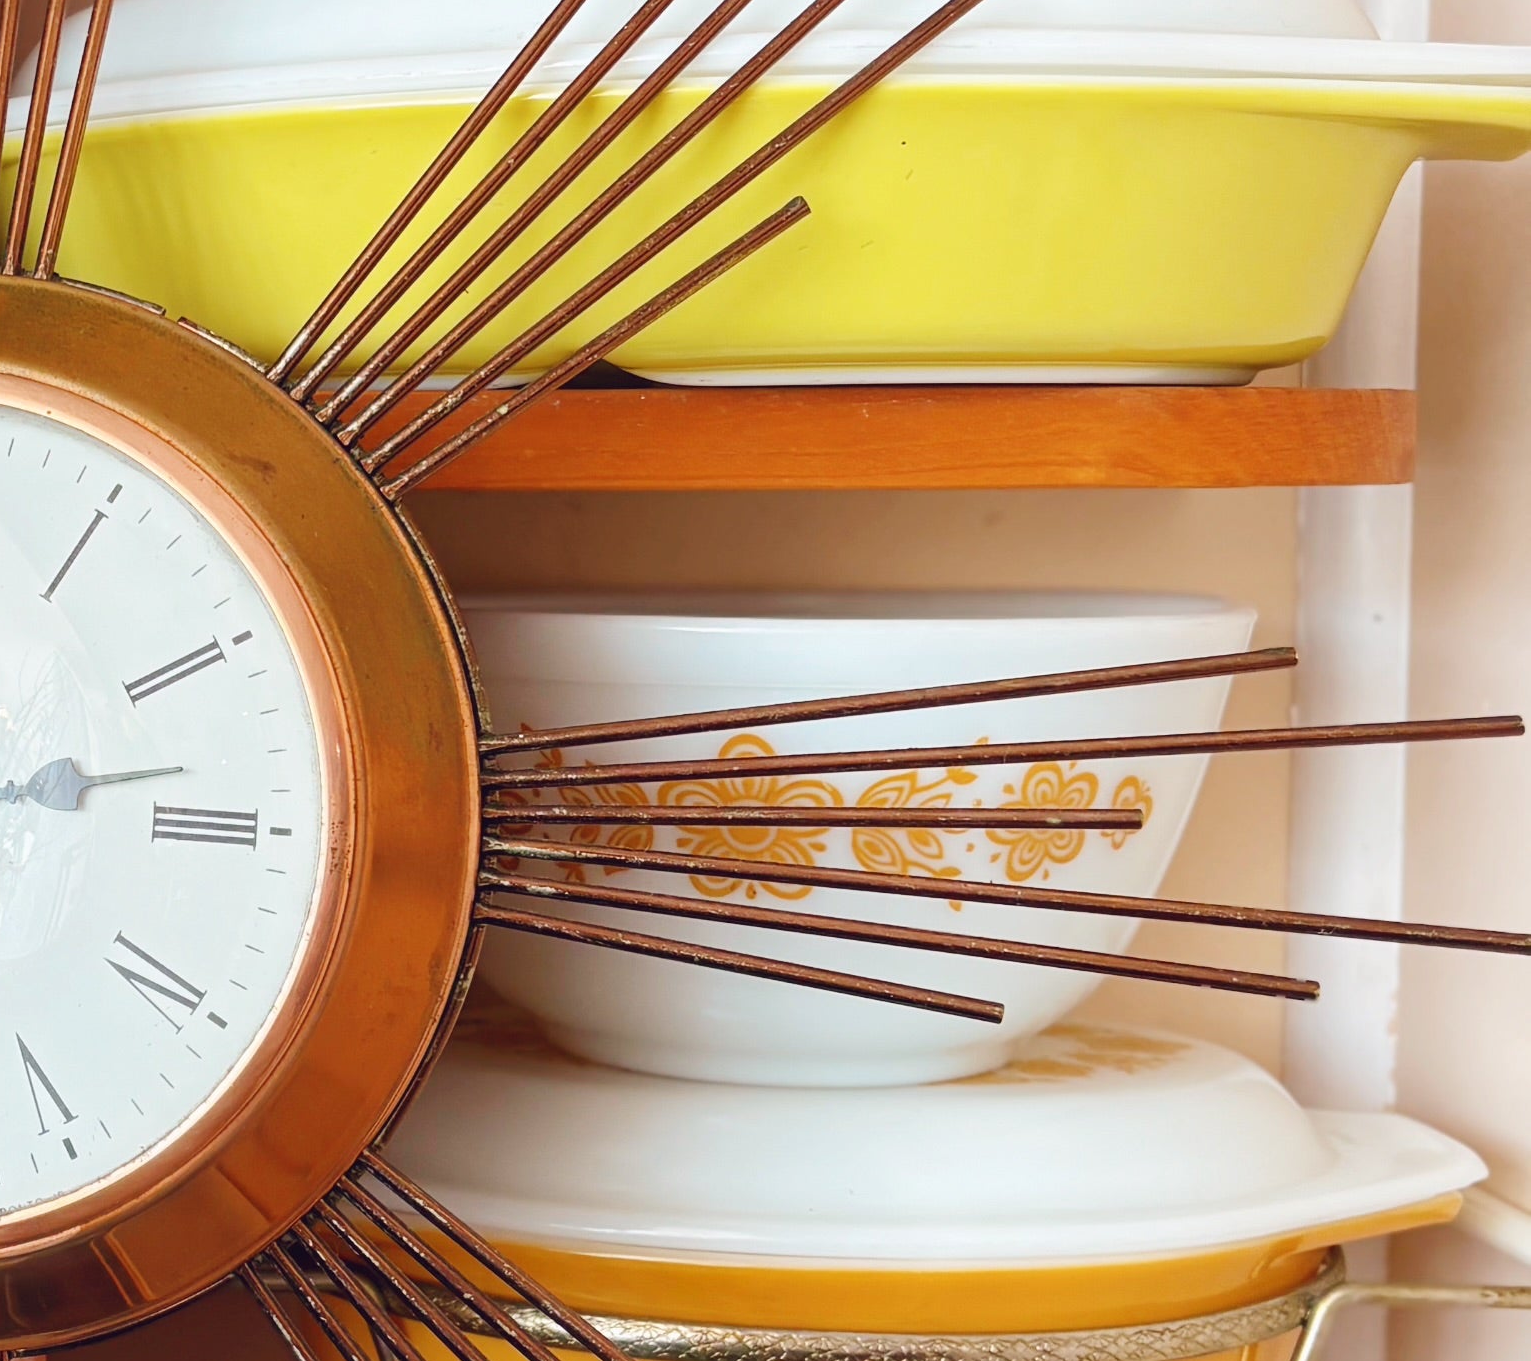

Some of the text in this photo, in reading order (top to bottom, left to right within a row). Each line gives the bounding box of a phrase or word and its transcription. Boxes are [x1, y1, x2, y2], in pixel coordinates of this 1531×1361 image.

[38, 508, 109, 604] I
[122, 634, 228, 709] II
[151, 800, 258, 852] III
[102, 929, 208, 1035] IV
[15, 1030, 79, 1136] V
